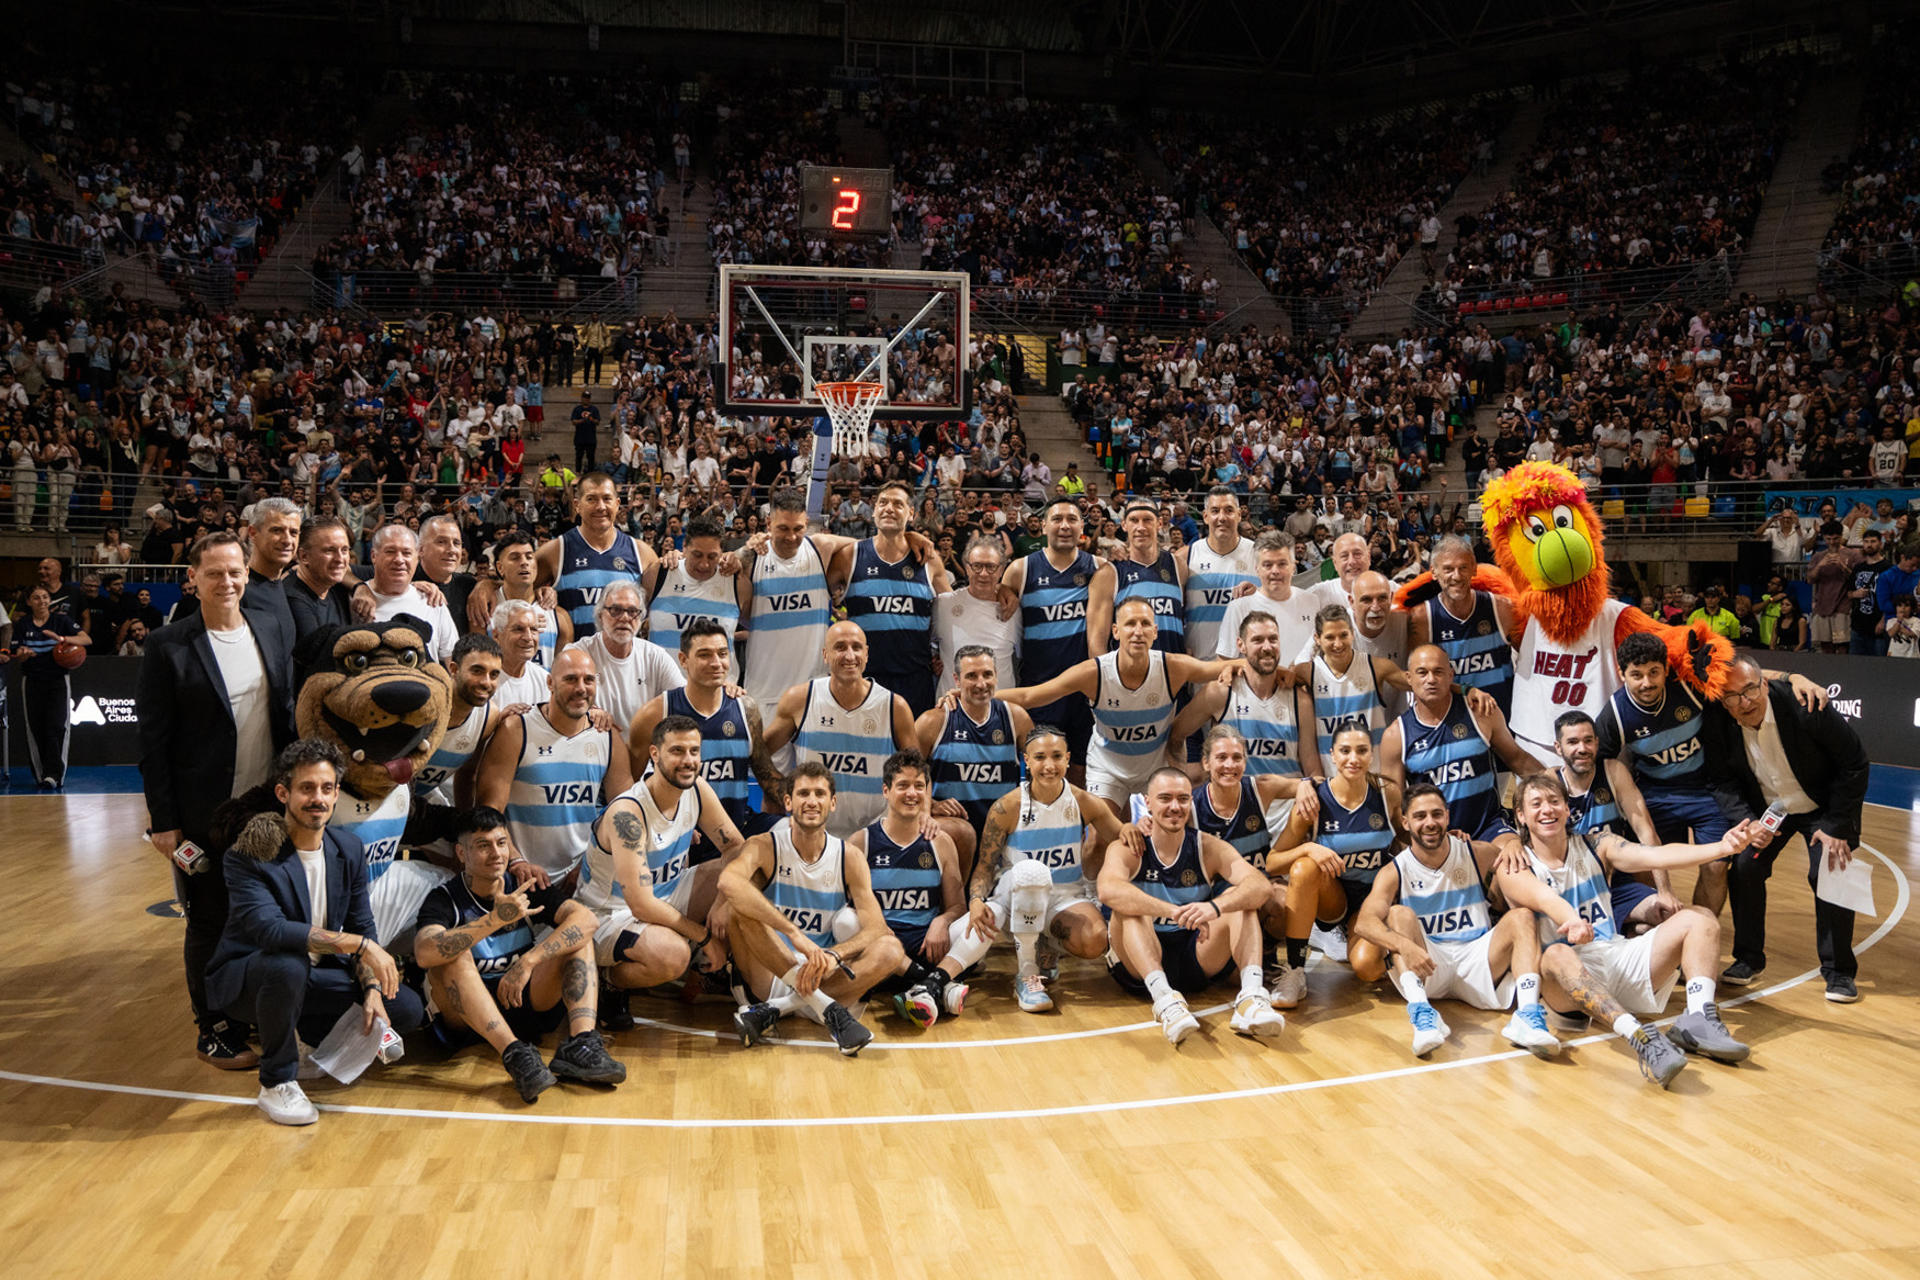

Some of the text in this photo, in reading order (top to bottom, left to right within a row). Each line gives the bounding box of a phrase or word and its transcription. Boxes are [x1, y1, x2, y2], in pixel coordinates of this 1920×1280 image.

[832, 190, 861, 229] 2
[1879, 459, 1895, 470] 20
[578, 587, 603, 605] VI
[768, 594, 812, 611] VISA
[870, 596, 914, 614] VISA
[1204, 589, 1235, 604] VIS
[1041, 601, 1086, 621] VISA
[1148, 598, 1174, 615] ISA
[672, 614, 718, 630] VI
[1449, 653, 1495, 675] VISA
[1533, 647, 1598, 679] HEAT
[98, 697, 136, 706] Buenos
[1551, 680, 1587, 706] 00
[105, 706, 132, 714] Aires
[108, 714, 139, 722] Ciuda
[1832, 699, 1862, 719] DING
[1110, 725, 1158, 741] VISA
[1245, 740, 1286, 756] VISA
[1647, 737, 1702, 765] VISA
[701, 759, 735, 781] ISA
[818, 753, 867, 774] VISA
[954, 763, 1002, 782] VISA
[1424, 760, 1475, 786] VISA
[416, 767, 447, 783] SA
[541, 785, 593, 804] VISA
[876, 890, 929, 910] VISA
[1579, 902, 1607, 923] SA
[1418, 910, 1474, 935] VISA
